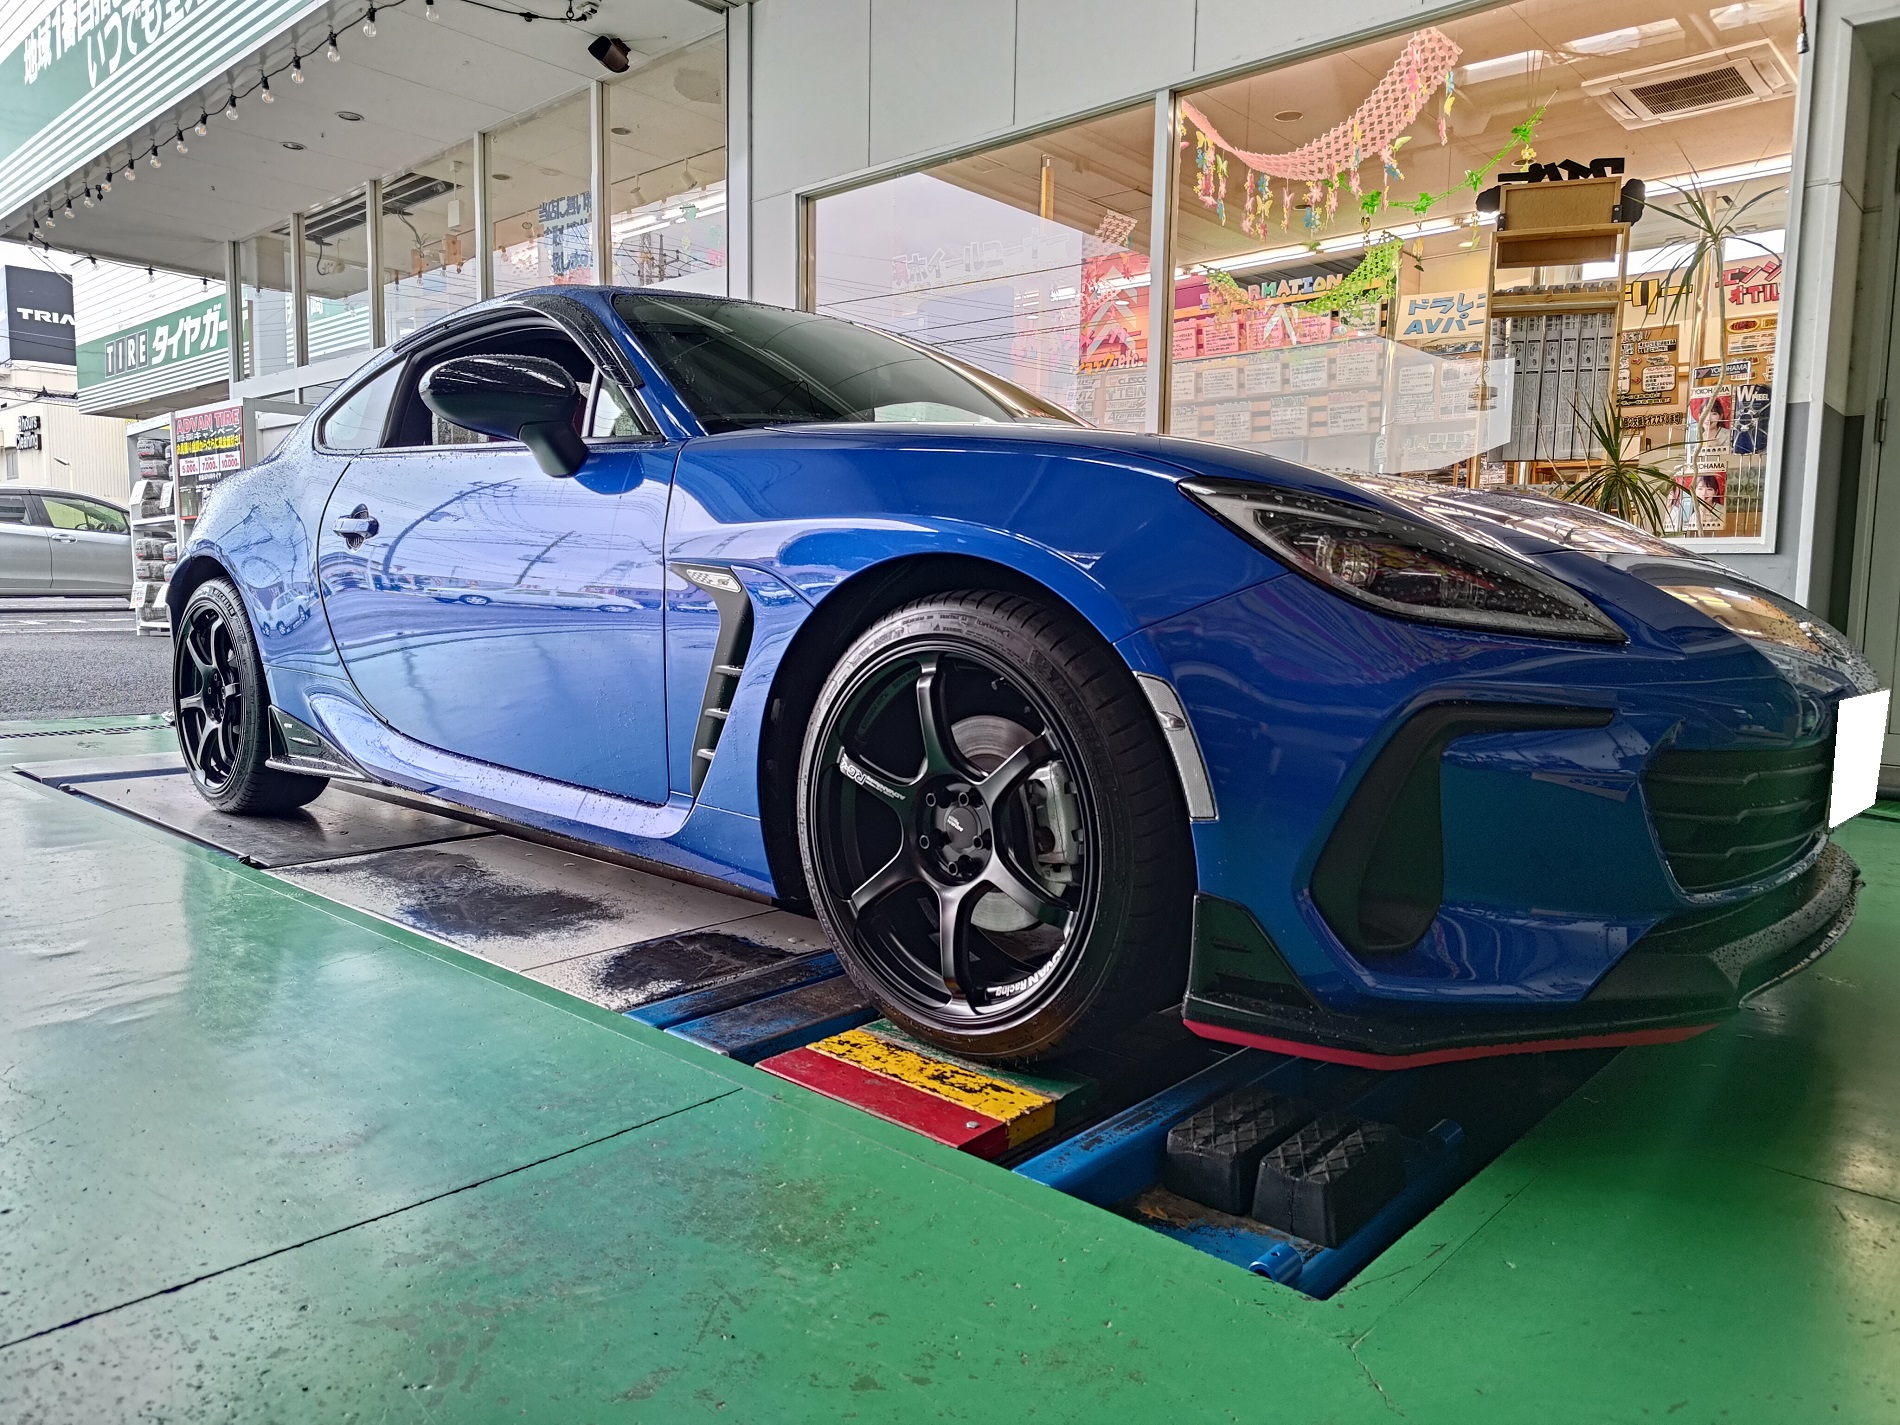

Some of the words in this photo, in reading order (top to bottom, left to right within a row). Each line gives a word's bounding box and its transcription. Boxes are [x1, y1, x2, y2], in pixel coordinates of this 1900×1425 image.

[1200, 273, 1343, 310] IRMATION
[152, 297, 248, 366] タイヤガー
[106, 334, 147, 374] TIRE
[1711, 363, 1748, 374] YOHAMA
[1694, 386, 1730, 395] YOKOHMA
[177, 413, 213, 435] ADVAN
[214, 409, 240, 427] TIRE
[995, 978, 1028, 997] Racing
